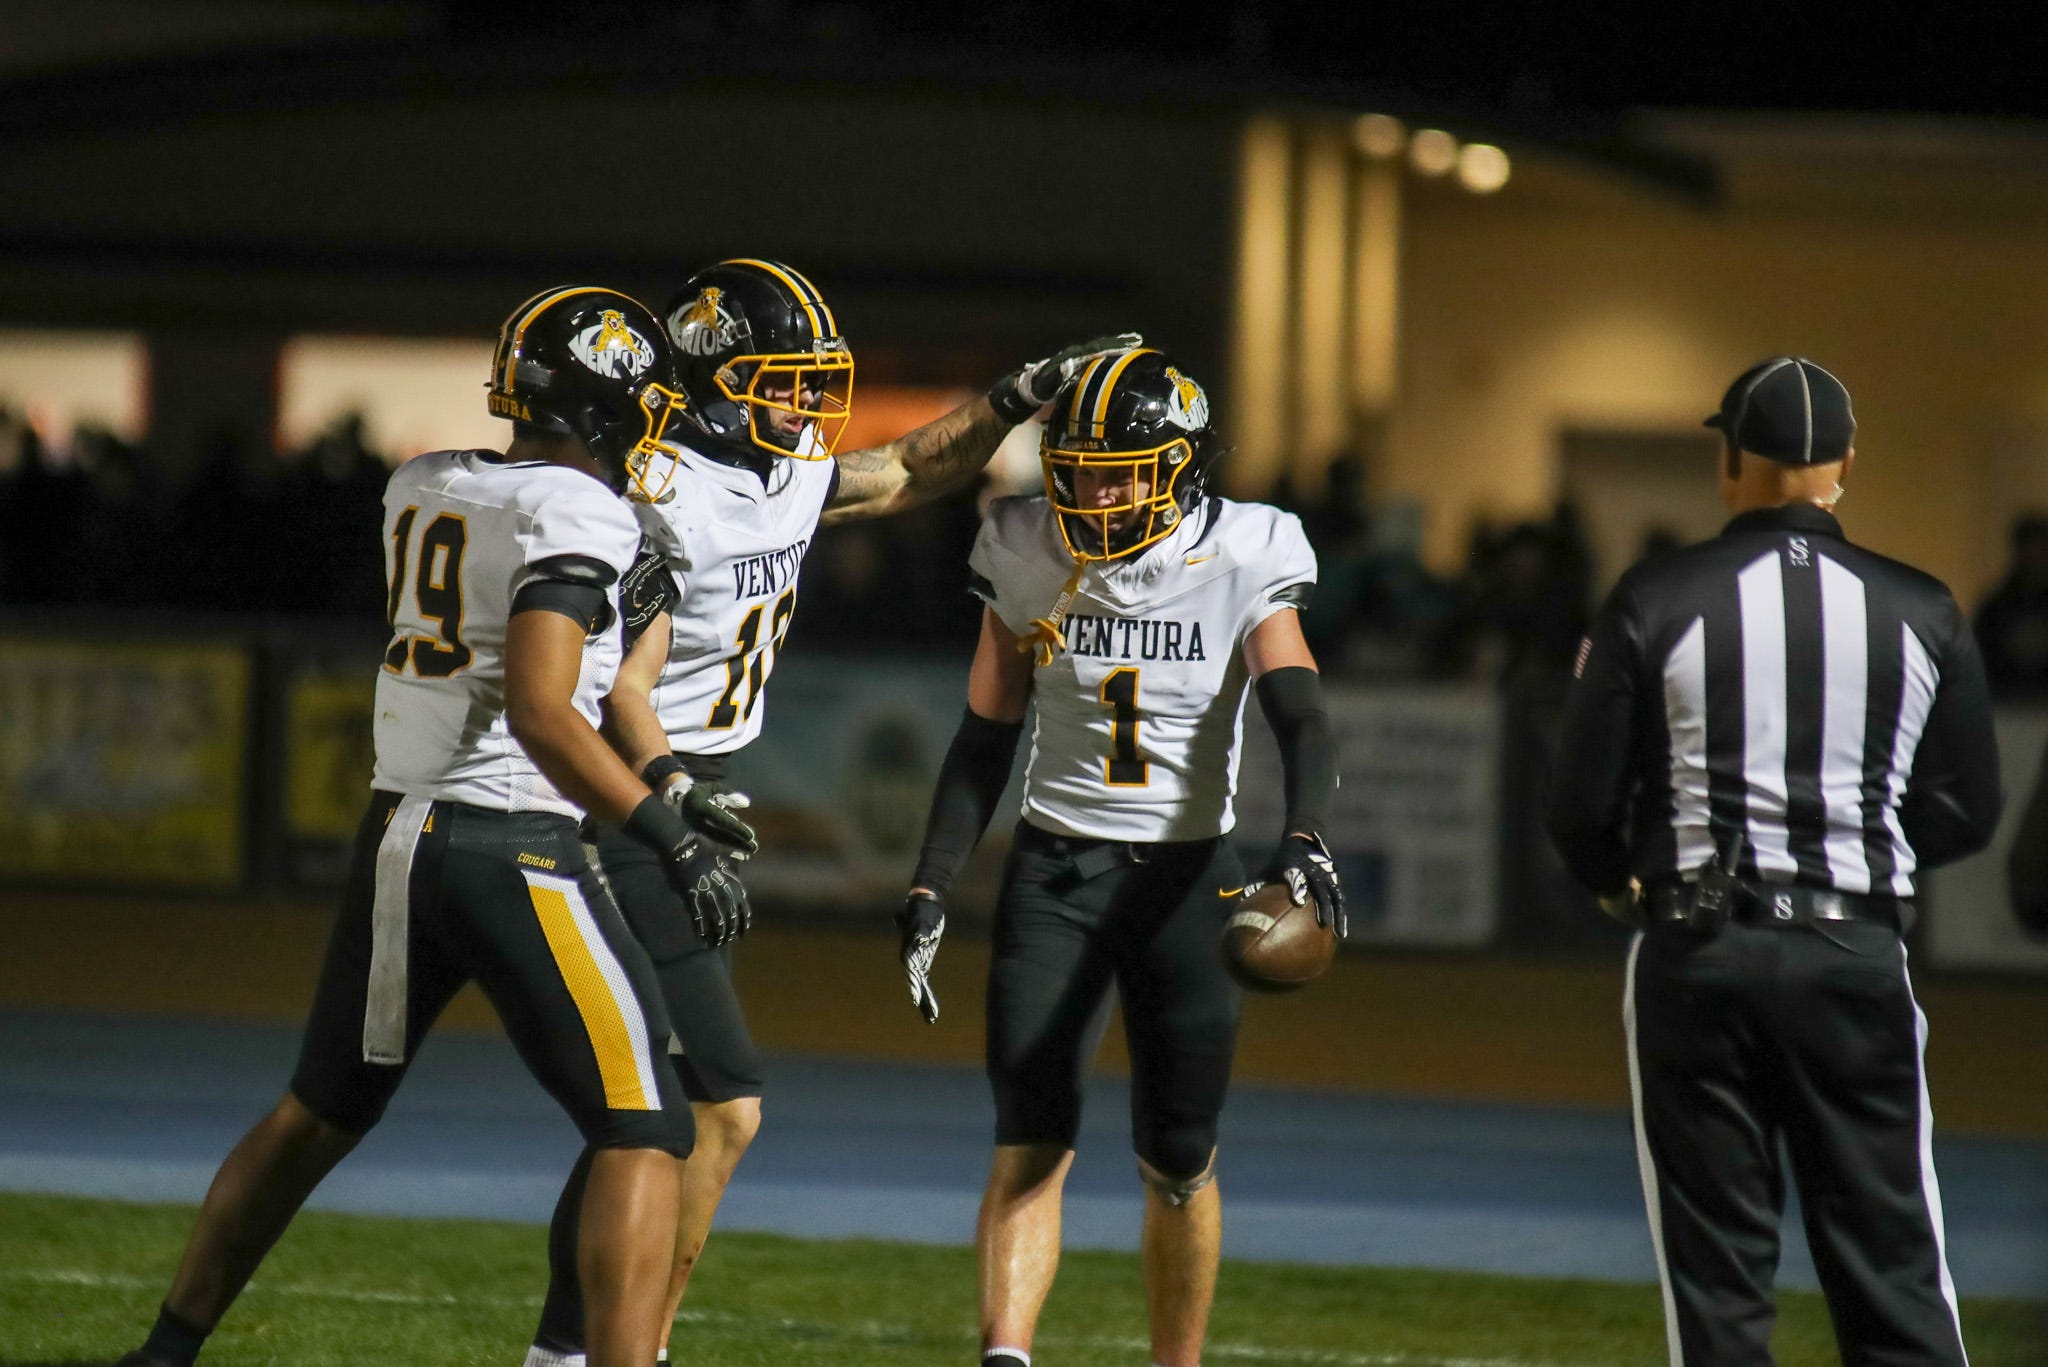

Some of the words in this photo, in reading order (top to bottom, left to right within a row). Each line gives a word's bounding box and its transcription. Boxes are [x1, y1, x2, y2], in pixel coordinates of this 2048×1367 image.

[385, 505, 474, 679] 19
[1057, 613, 1206, 661] VENTURA
[1100, 666, 1149, 787] 1
[517, 852, 556, 870] COUGARS
